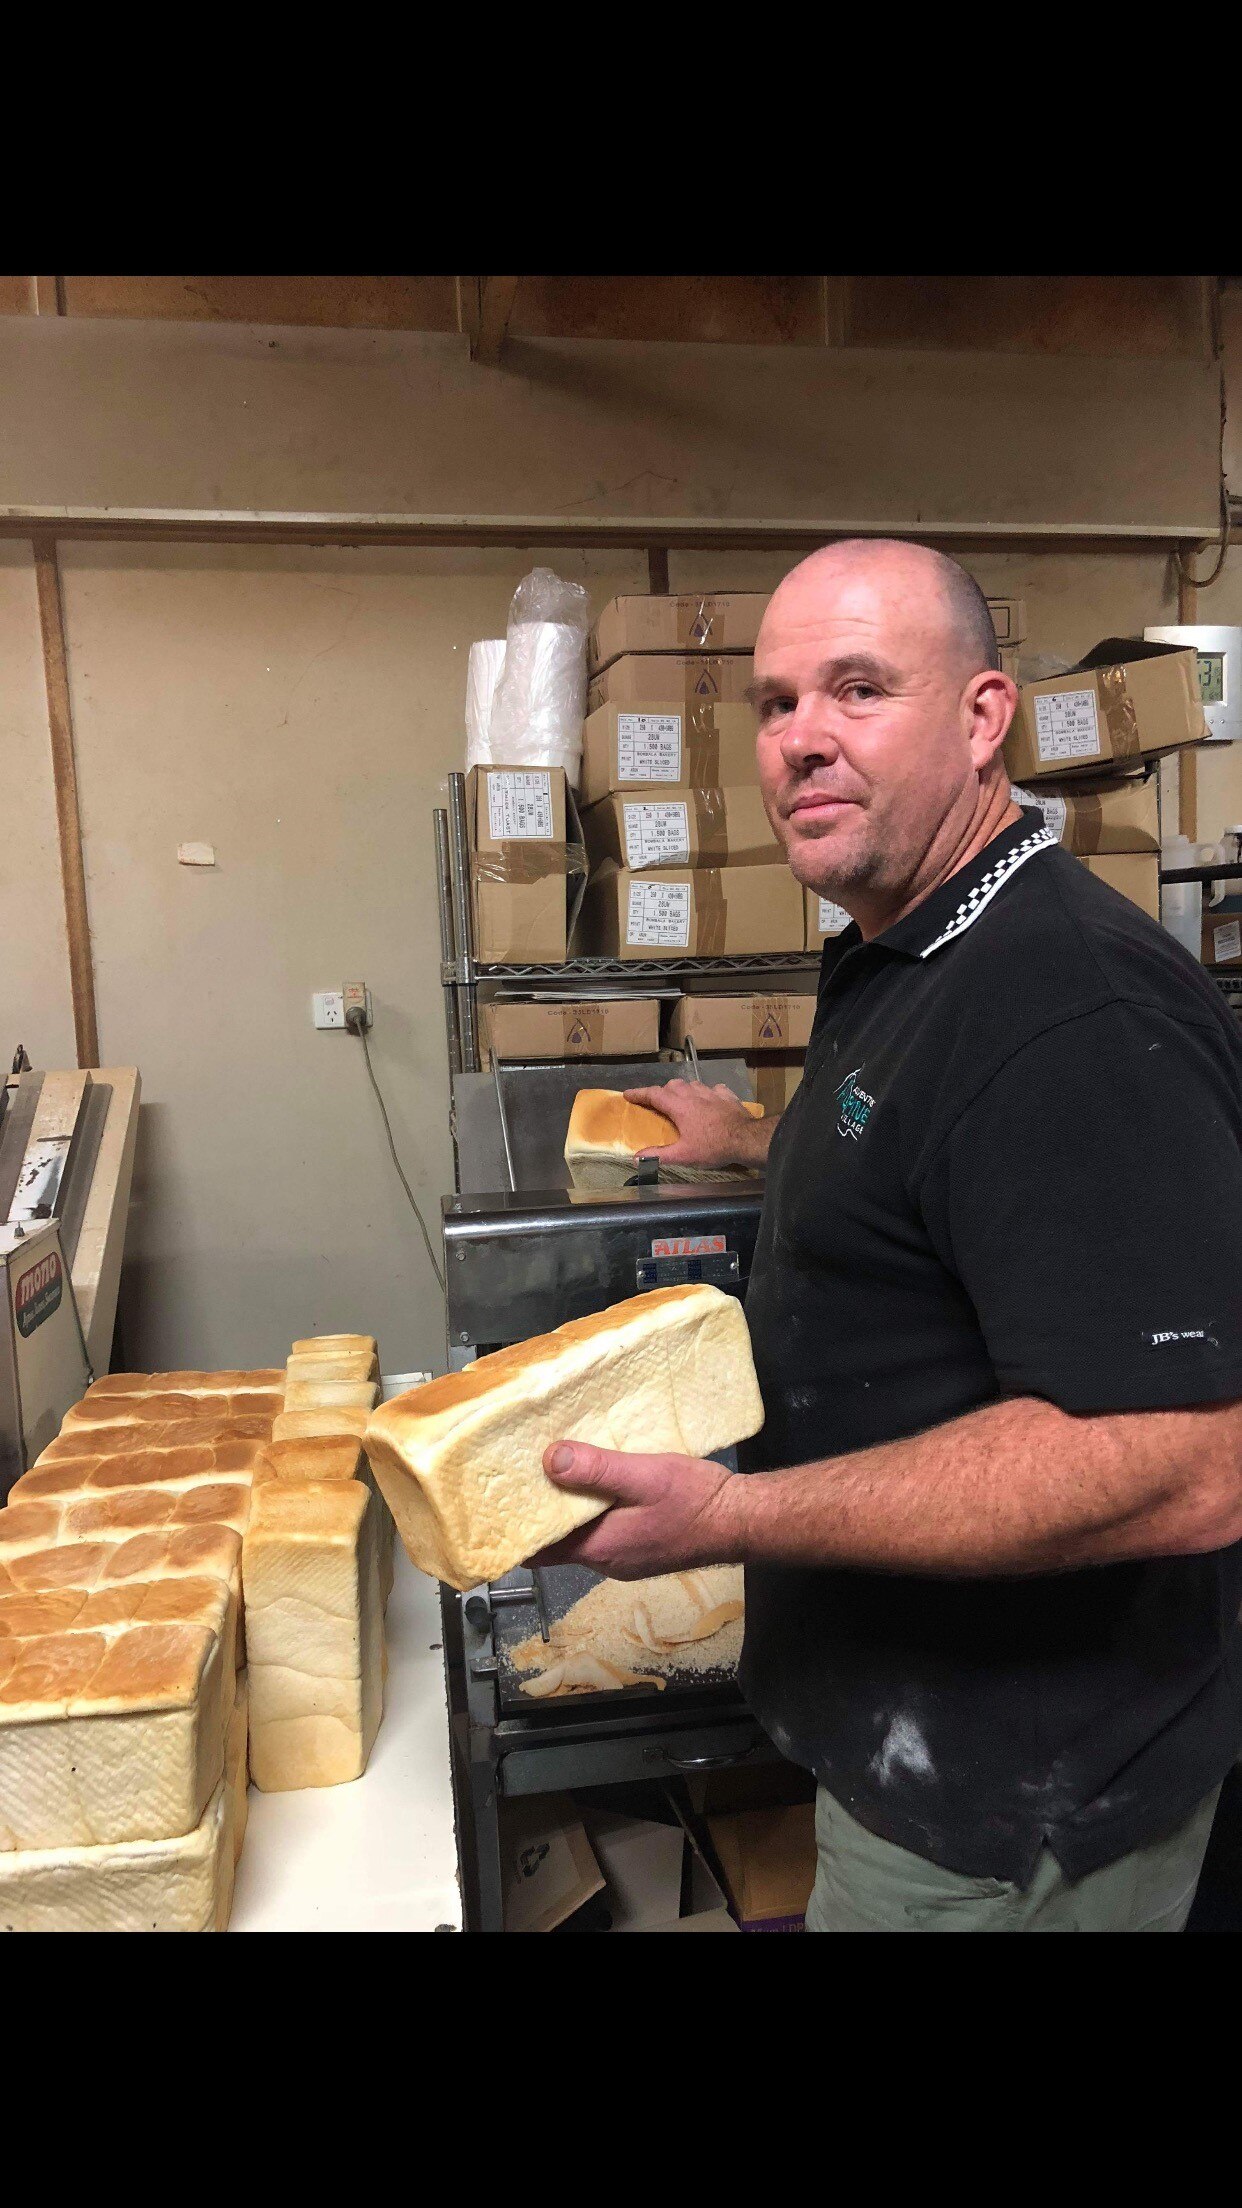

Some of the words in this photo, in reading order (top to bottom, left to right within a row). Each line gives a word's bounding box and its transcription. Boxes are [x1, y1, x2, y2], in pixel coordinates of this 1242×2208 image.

[654, 1236, 725, 1255] ATLAS
[21, 1255, 56, 1306] mono
[1152, 1332, 1179, 1345] JB's
